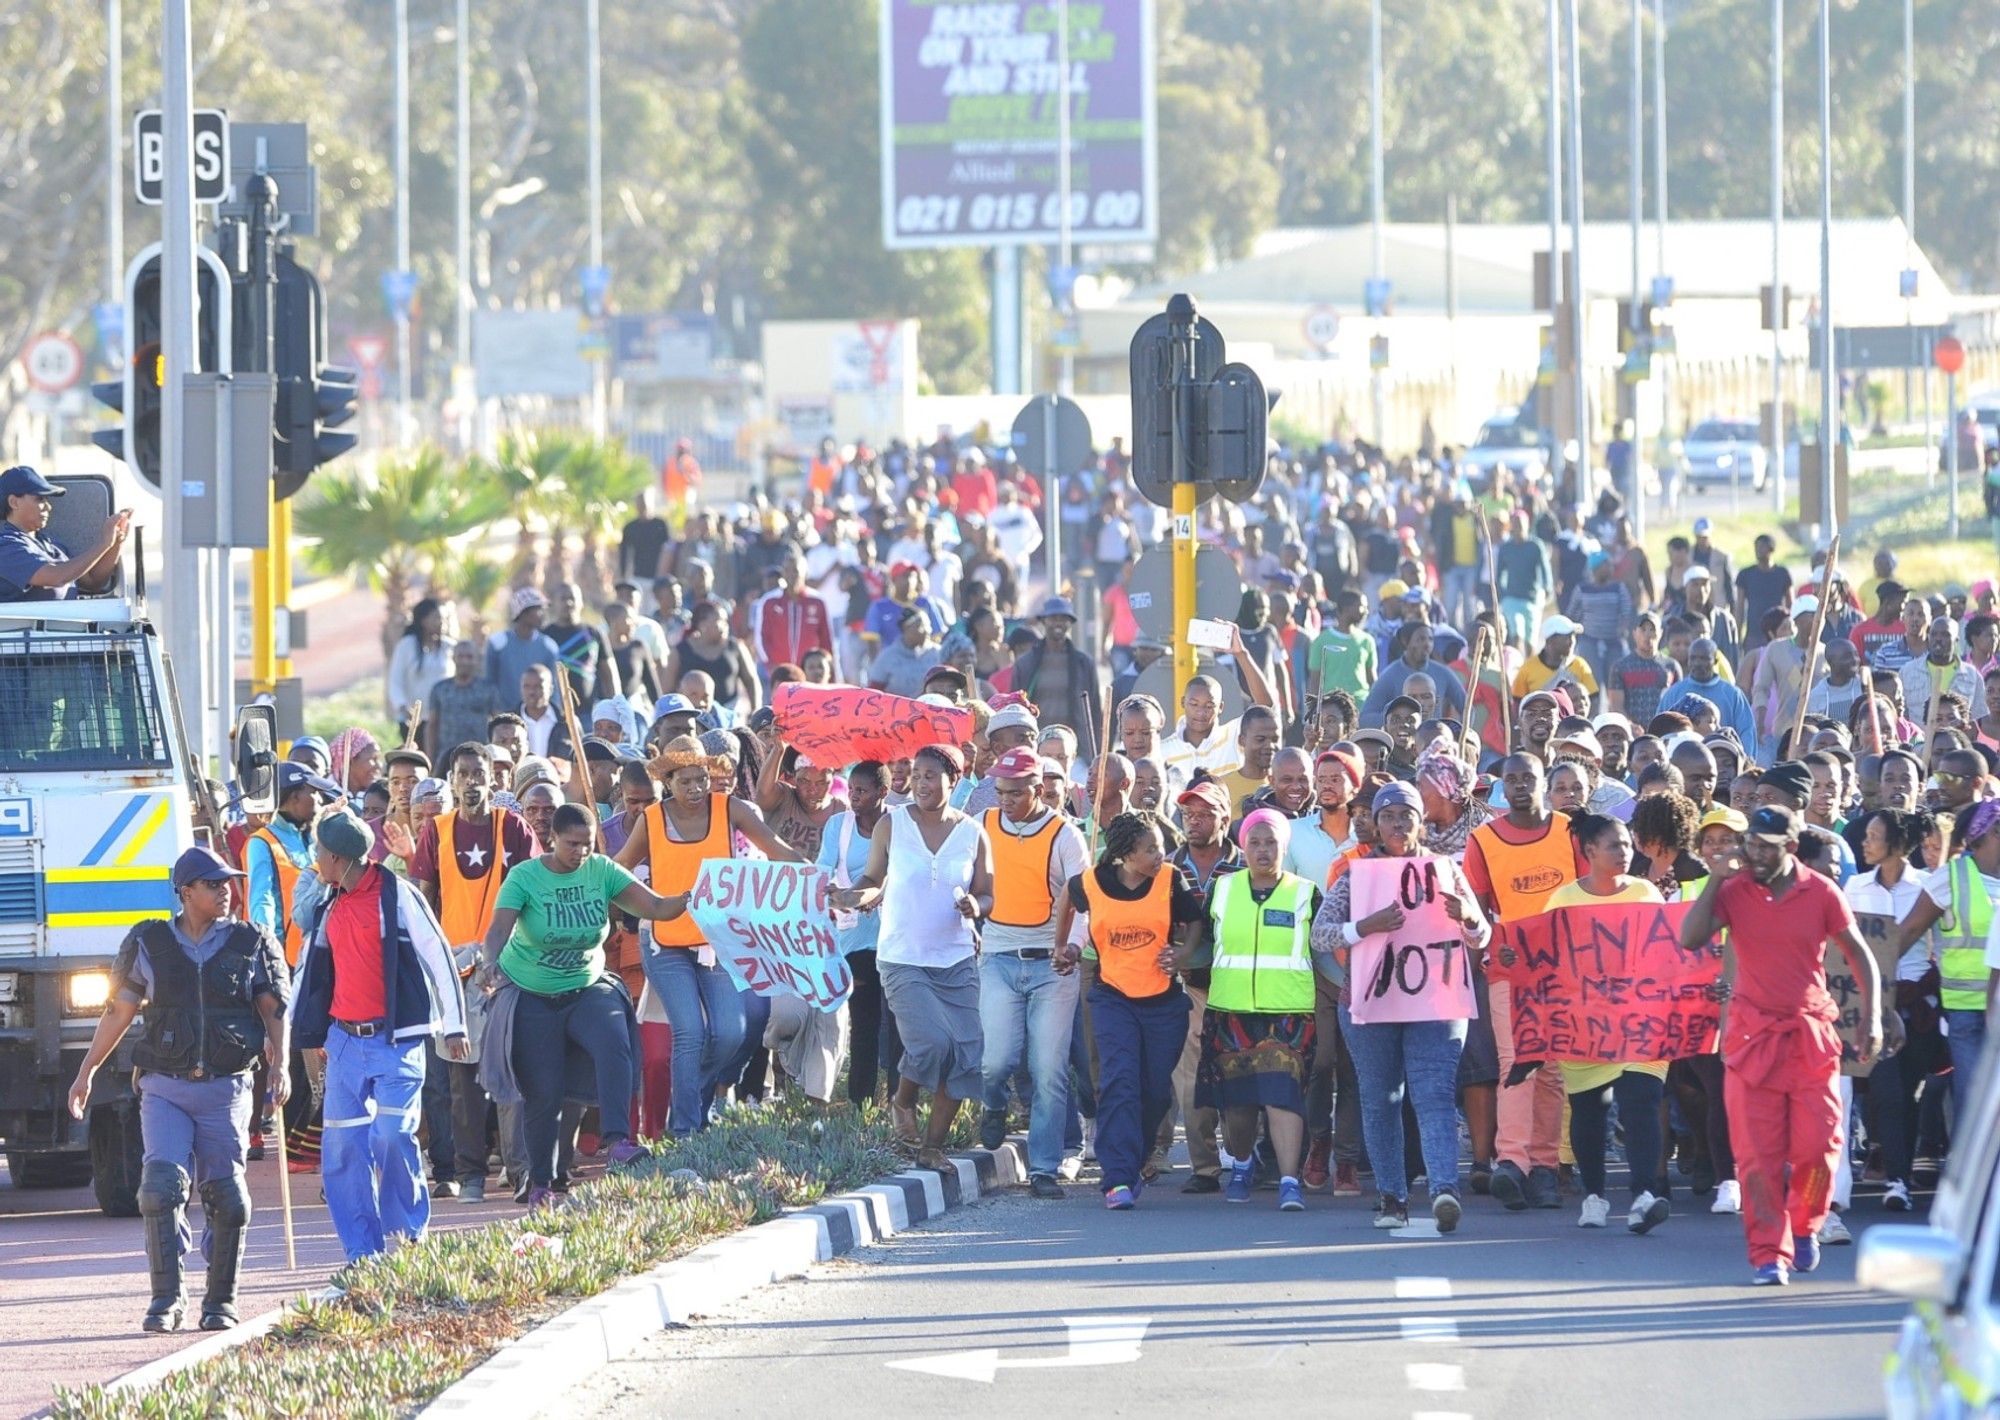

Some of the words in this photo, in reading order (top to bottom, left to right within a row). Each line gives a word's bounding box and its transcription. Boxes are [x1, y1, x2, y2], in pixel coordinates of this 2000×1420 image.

[142, 131, 221, 182] BS
[898, 196, 961, 231] 021
[1174, 518, 1190, 536] 14
[555, 885, 585, 903] GREAT
[543, 898, 608, 929] THINGS
